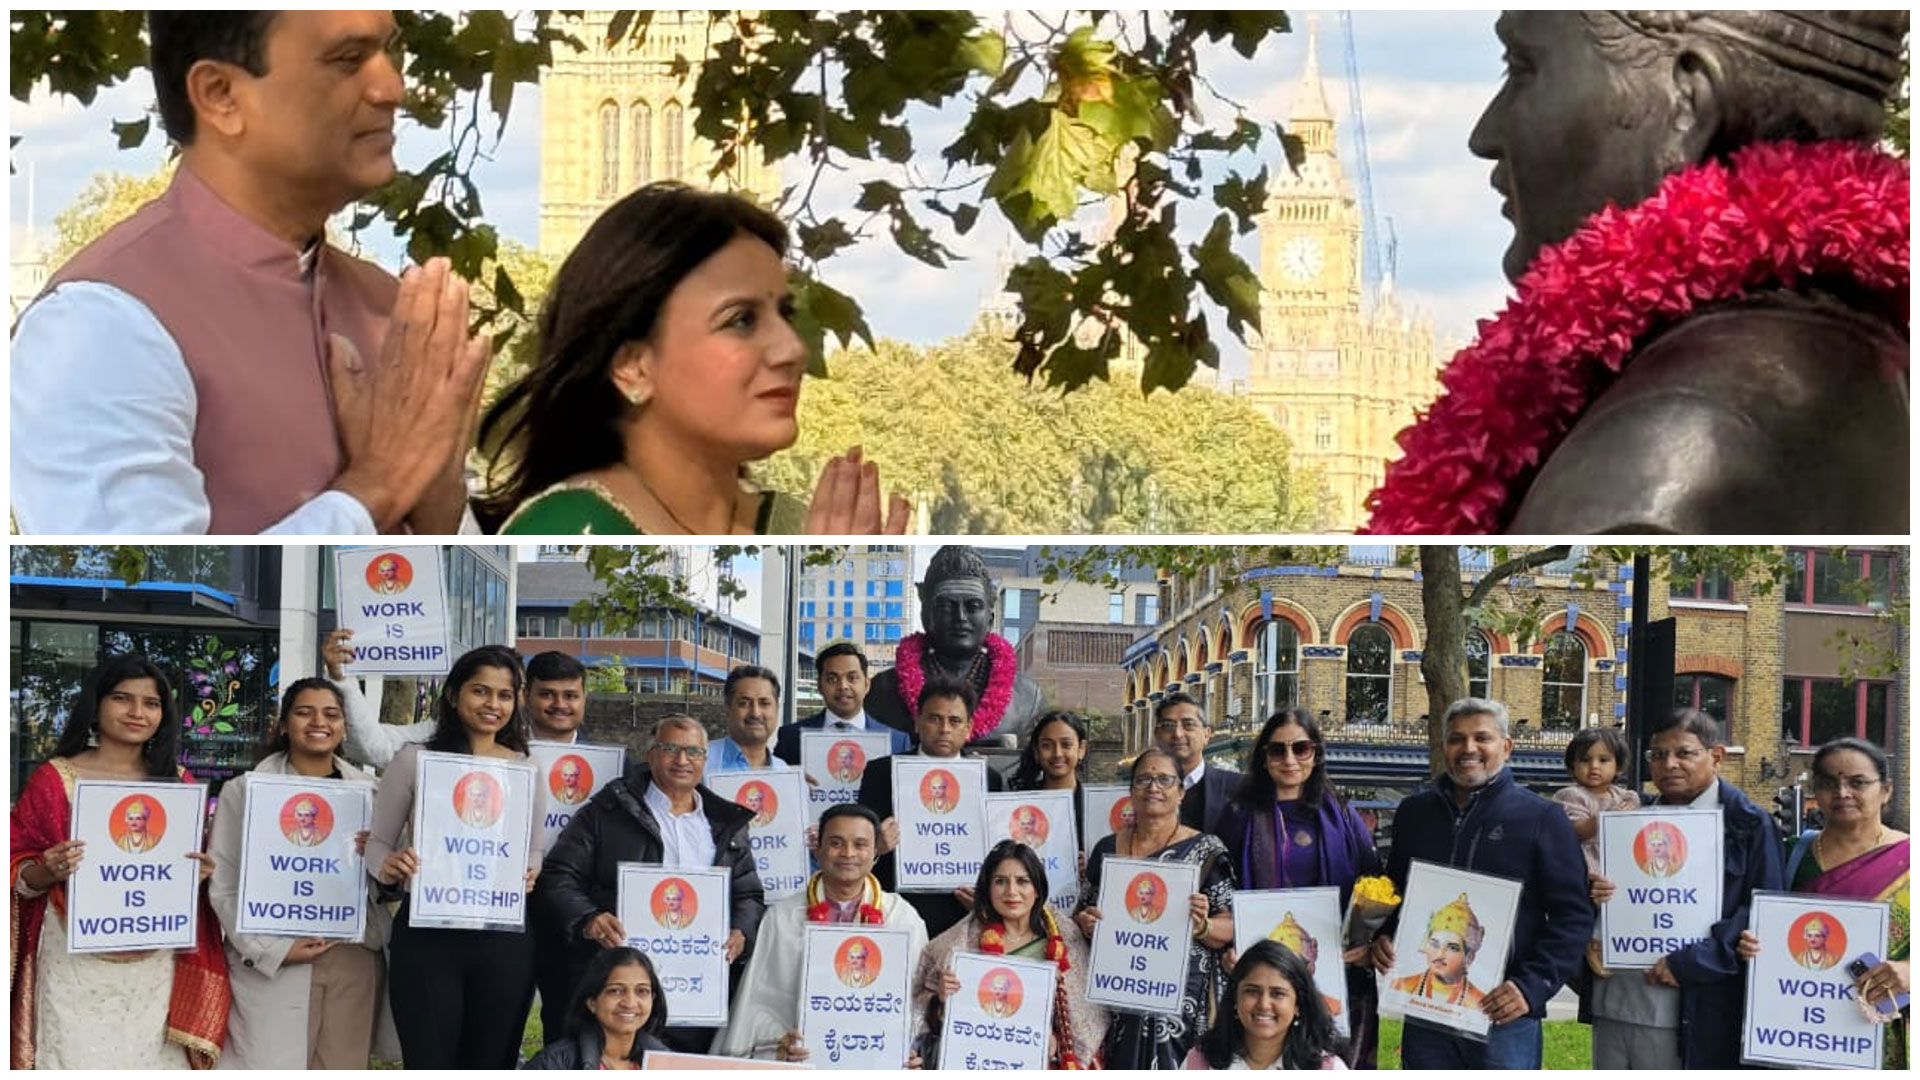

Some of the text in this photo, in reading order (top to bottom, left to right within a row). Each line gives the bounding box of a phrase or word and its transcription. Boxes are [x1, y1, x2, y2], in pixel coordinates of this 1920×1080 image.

[362, 602, 425, 617] WORK
[386, 623, 404, 638] IS
[916, 822, 968, 836] WORK
[445, 836, 510, 858] WORK
[749, 835, 788, 850] ORK
[935, 842, 951, 856] IS
[99, 864, 173, 882] WORK
[270, 855, 341, 874] WORK
[468, 864, 486, 881] IS
[294, 880, 314, 897] IS
[764, 876, 804, 891] SHIP
[125, 890, 146, 907] IS
[424, 886, 520, 909] WORSHIP
[1627, 887, 1697, 904] WORK
[248, 901, 355, 921] WORSHIP
[79, 914, 189, 936] WORSHIP
[1653, 912, 1673, 929] IS
[1115, 930, 1169, 951] WORK
[1130, 955, 1147, 971] IS
[1095, 973, 1177, 998] WORSHIP
[1778, 978, 1855, 1001] WORK
[810, 992, 903, 1014] ಕಾಯಕವೇ
[1803, 1006, 1825, 1024] IS
[953, 1020, 1041, 1047] ಕಾಯಕವೇ
[1756, 1027, 1872, 1054] WORSHIP
[825, 1029, 885, 1062] ಕೈಲಾಸ
